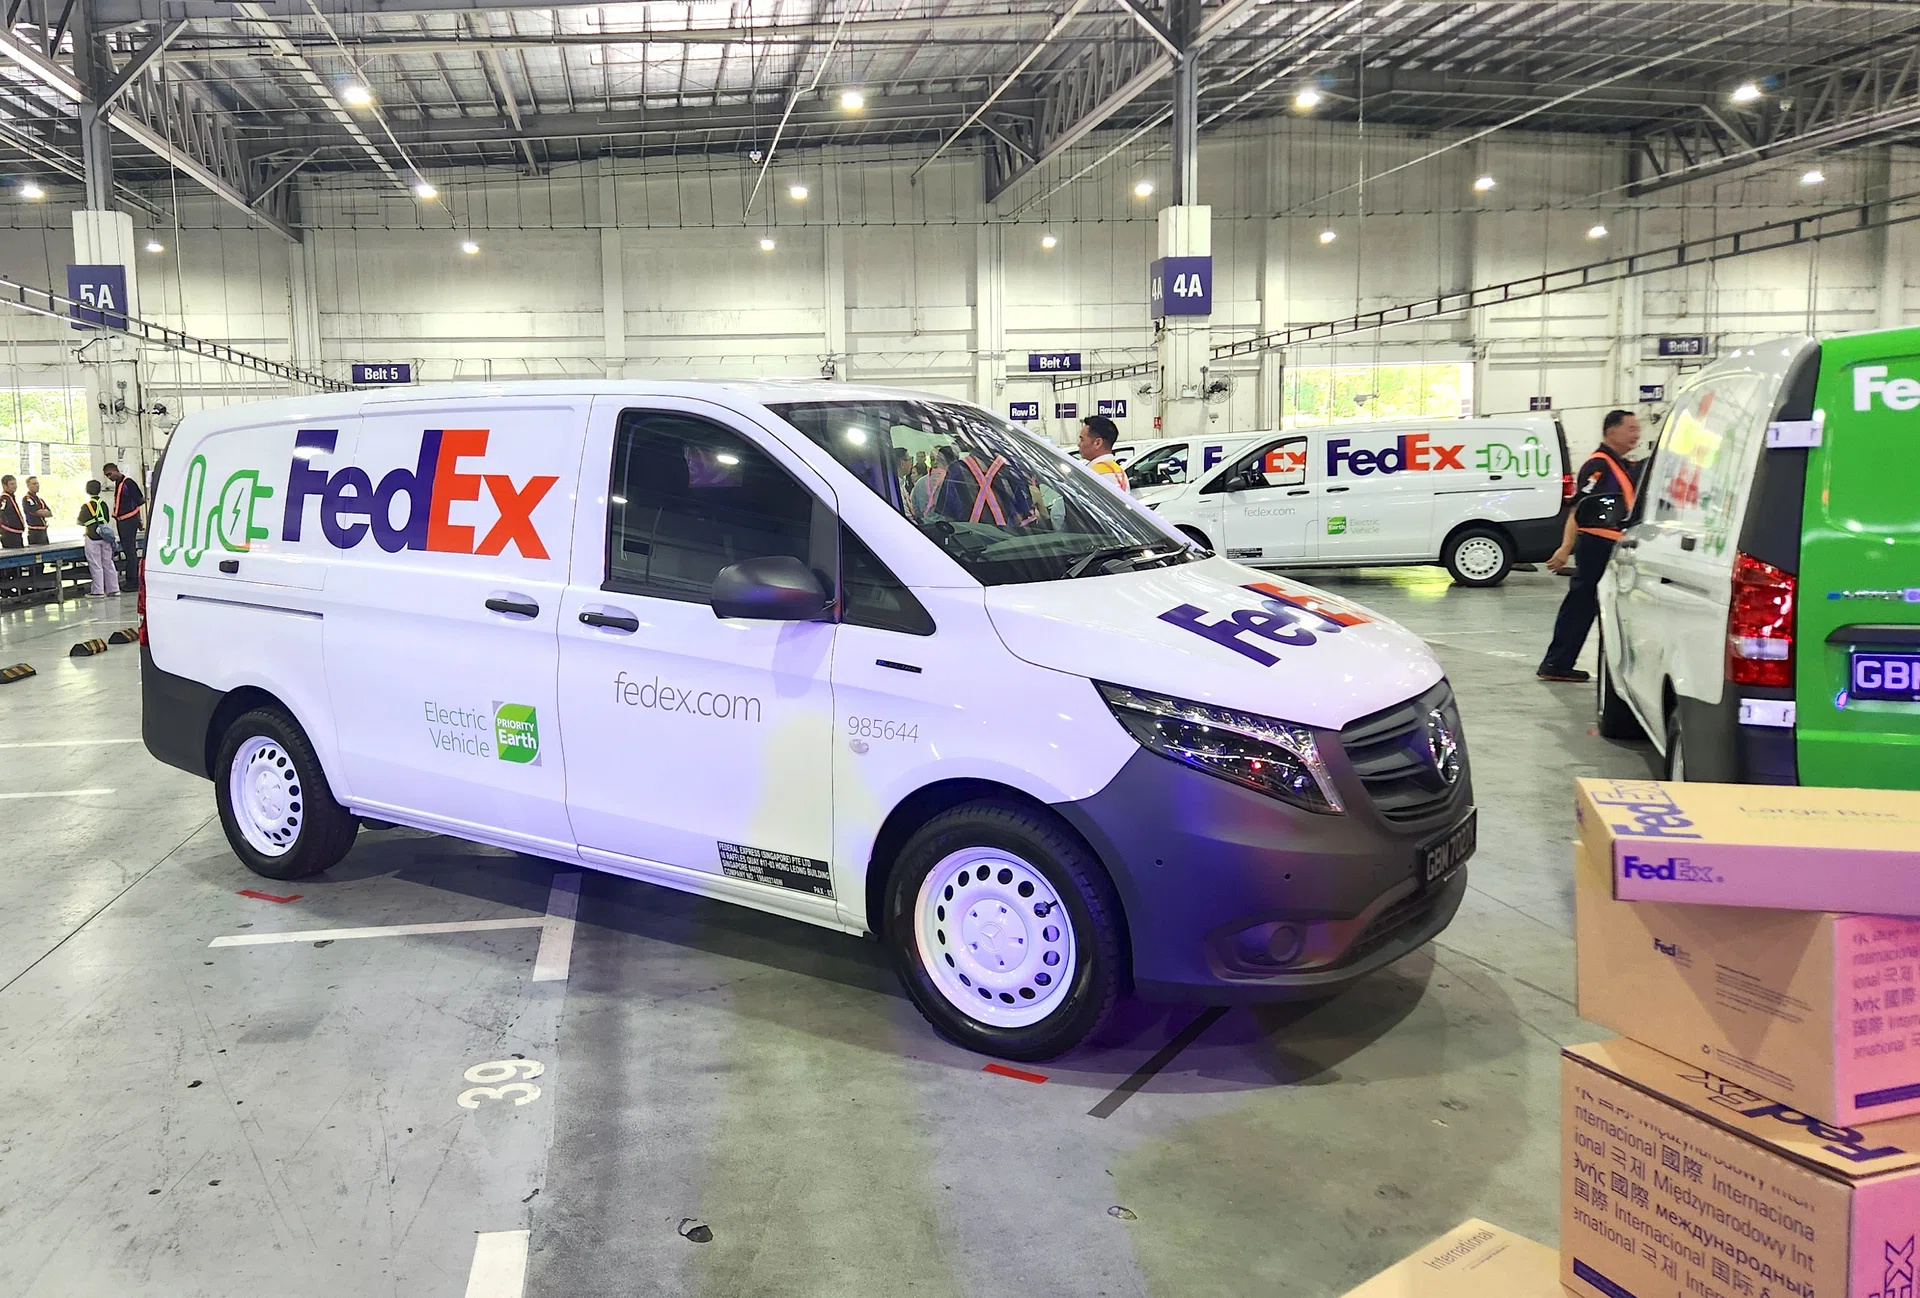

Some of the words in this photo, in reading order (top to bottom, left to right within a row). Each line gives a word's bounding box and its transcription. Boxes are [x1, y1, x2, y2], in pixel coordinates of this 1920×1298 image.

[80, 284, 115, 309] 5A
[1151, 276, 1163, 301] 4A
[1173, 273, 1204, 297] 4A
[1691, 340, 1699, 352] 3
[364, 367, 388, 380] Belt
[391, 367, 399, 380] 5
[1039, 356, 1061, 369] Belt
[1063, 356, 1071, 369] 4
[1011, 407, 1028, 417] Row
[1029, 404, 1037, 416] B
[1117, 402, 1125, 414] A
[1326, 433, 1466, 477] FedEx
[282, 429, 560, 560] FedEx
[1244, 507, 1296, 517] fedex.com
[614, 671, 761, 723] fedex.com
[424, 701, 488, 731] Electric
[497, 717, 535, 732] PRIORITY
[498, 728, 538, 750] Earth
[848, 716, 919, 743] 985644
[429, 727, 490, 758] Vehicle
[719, 843, 739, 853] FEDERAL
[740, 846, 760, 858] EXPRESS
[761, 850, 792, 864] (SINGAPORE)
[792, 856, 802, 866] PTE
[802, 858, 812, 867] LTD
[723, 860, 750, 872] SINGAPORE
[726, 852, 747, 864] RAFFLES
[747, 856, 760, 866] QUAY
[775, 862, 790, 872] HONG
[790, 865, 807, 876] LEONG
[807, 868, 830, 880] BUILDING
[724, 868, 746, 879] COMPANY
[1623, 855, 1714, 884] FedEx
[813, 886, 824, 895] PAX
[457, 1059, 545, 1109] 39
[1610, 1145, 1646, 1181] 국제
[1653, 1169, 1787, 1259] Międzynarodowy
[1575, 1177, 1609, 1212] 国際
[1615, 1201, 1706, 1269] Internacional
[1712, 1256, 1754, 1296] 国际
[1423, 1228, 1497, 1271] International
[1641, 1242, 1678, 1281] 국제
[1656, 1203, 1815, 1298] международный
